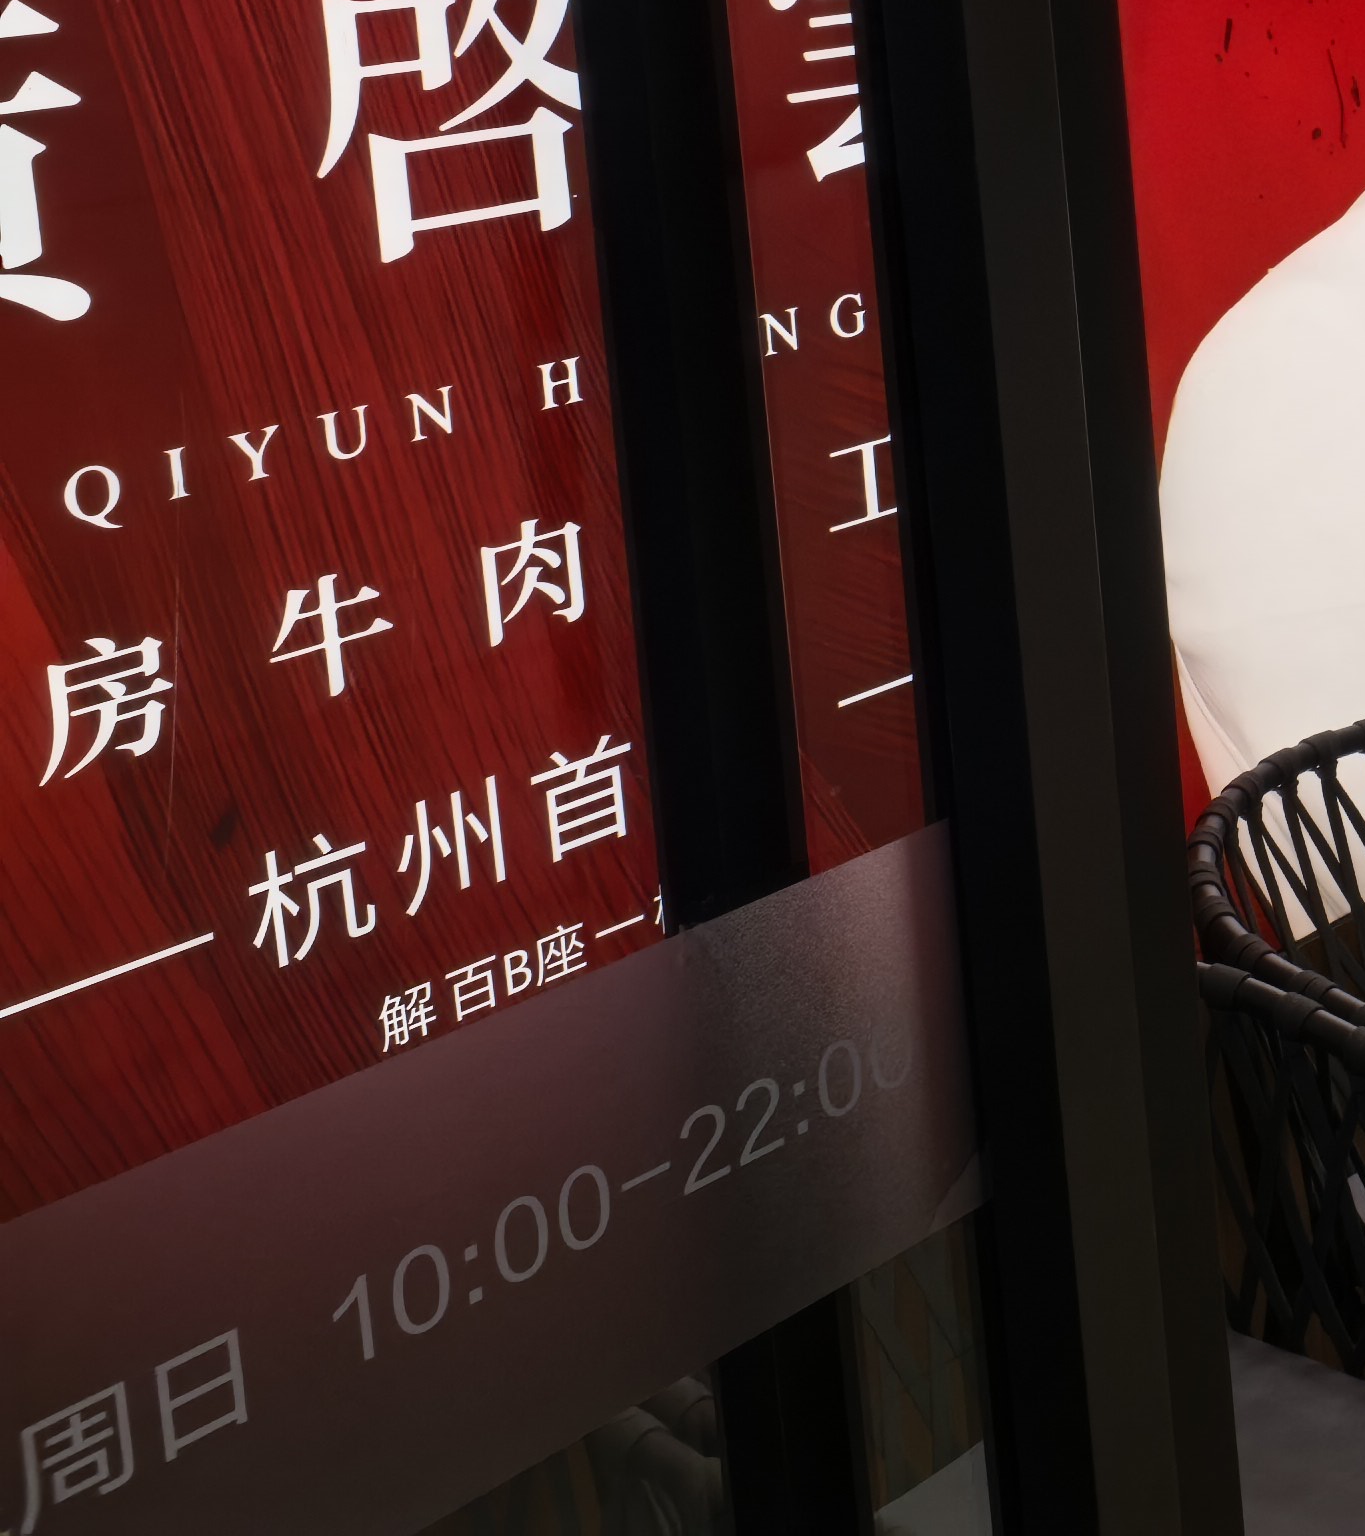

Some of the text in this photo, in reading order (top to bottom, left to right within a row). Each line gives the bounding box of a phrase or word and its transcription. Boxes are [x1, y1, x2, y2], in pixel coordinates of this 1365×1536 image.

[64, 385, 453, 529] QIYUN
[378, 884, 666, 1052] 解百B座一
